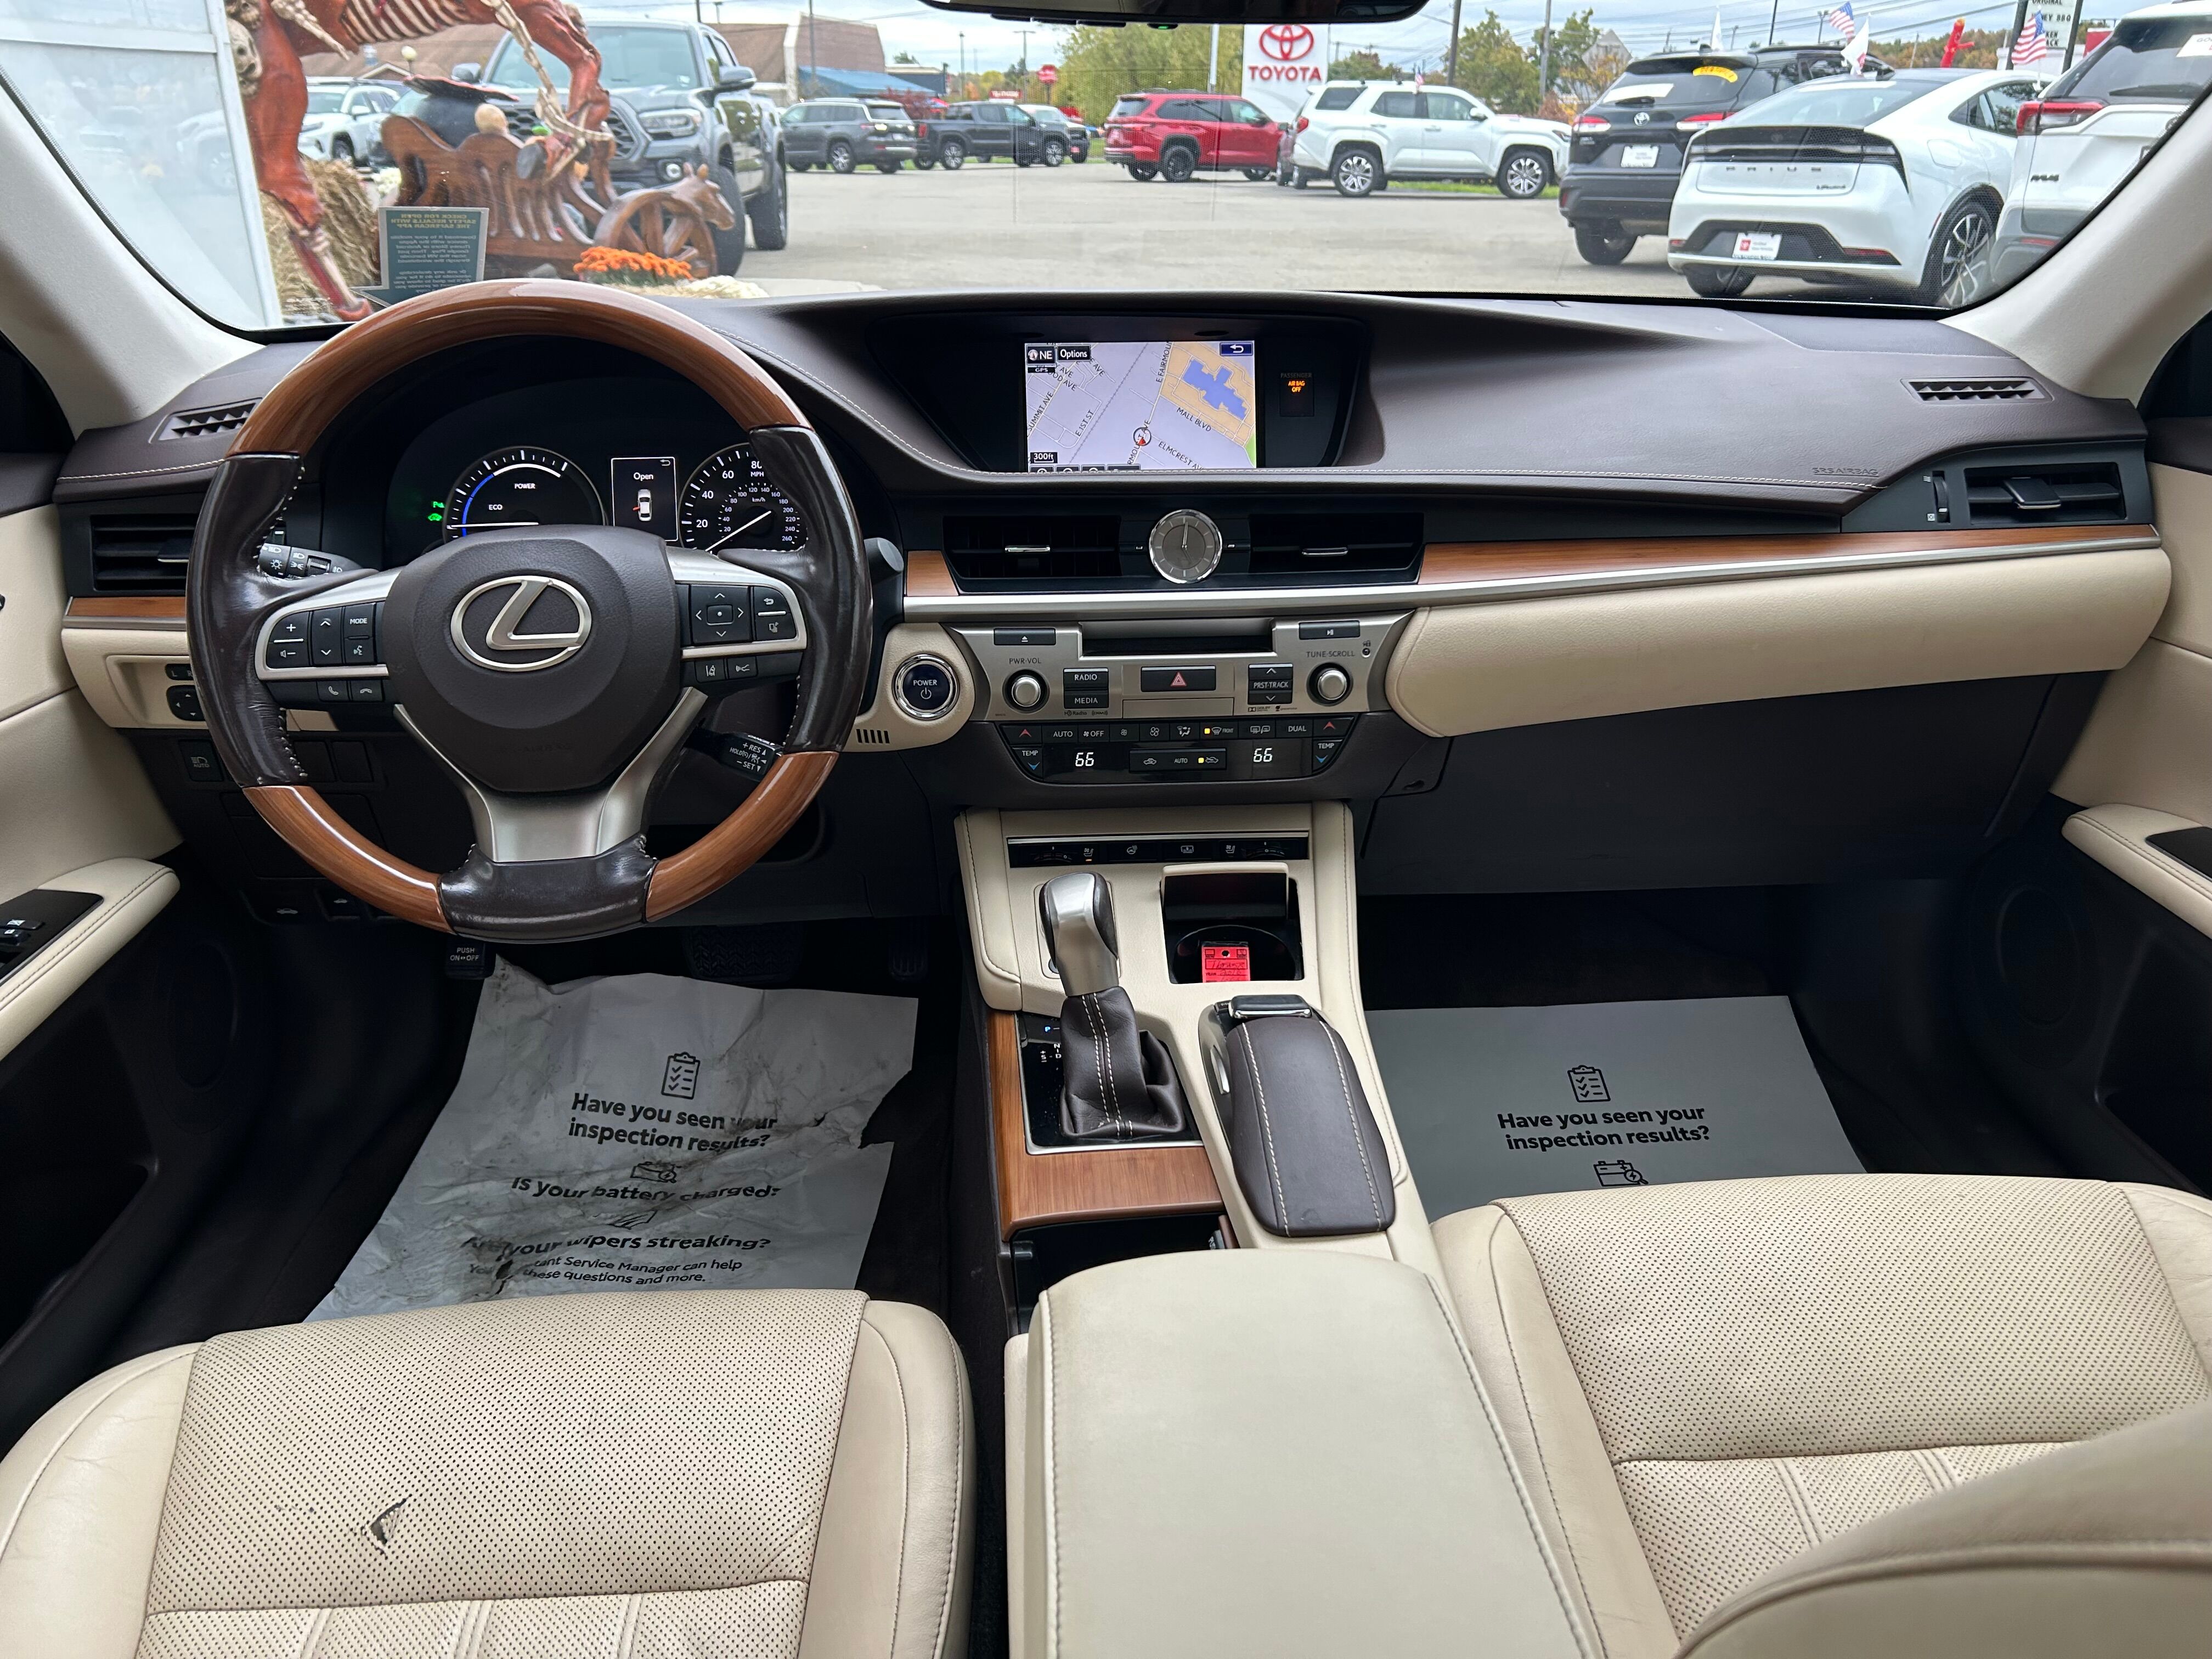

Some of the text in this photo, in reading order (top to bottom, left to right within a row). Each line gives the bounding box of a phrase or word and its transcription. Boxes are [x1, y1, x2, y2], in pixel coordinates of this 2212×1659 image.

[1248, 66, 1322, 81] TOYOTA
[1040, 349, 1087, 359] NE Options
[1059, 366, 1074, 378] AVE
[1093, 363, 1105, 377] AVE
[1063, 379, 1077, 392] AVE
[1042, 391, 1054, 407] AVE
[1086, 409, 1094, 419] ST
[1176, 407, 1212, 432] MALL BLVD
[1158, 441, 1193, 466] ELMCREST
[634, 472, 653, 481] Open
[722, 470, 734, 479] 60
[702, 490, 714, 499] 40
[696, 520, 708, 528] 20
[730, 747, 743, 755] HOLD
[749, 744, 761, 753] RES
[1253, 748, 1273, 763] 66
[743, 761, 755, 770] SET
[1075, 752, 1094, 767] 66
[571, 1093, 626, 1116] Have
[629, 1103, 672, 1123] you
[675, 1111, 724, 1130] seen
[1497, 1107, 1705, 1130] Have you seen your
[568, 1117, 770, 1152] inspection results?
[1505, 1125, 1710, 1152] inspection results?
[511, 1177, 532, 1190] Is
[532, 1181, 589, 1198] your
[591, 1186, 675, 1201] battery
[505, 1242, 562, 1257] your
[567, 1235, 642, 1249] wipers
[647, 1235, 771, 1250] streaking?
[564, 1256, 615, 1269] Service
[618, 1262, 681, 1274] Manager
[683, 1261, 707, 1271] can
[710, 1259, 743, 1271] help
[564, 1271, 633, 1284] questions
[635, 1273, 662, 1285] and
[665, 1272, 706, 1283] more.
